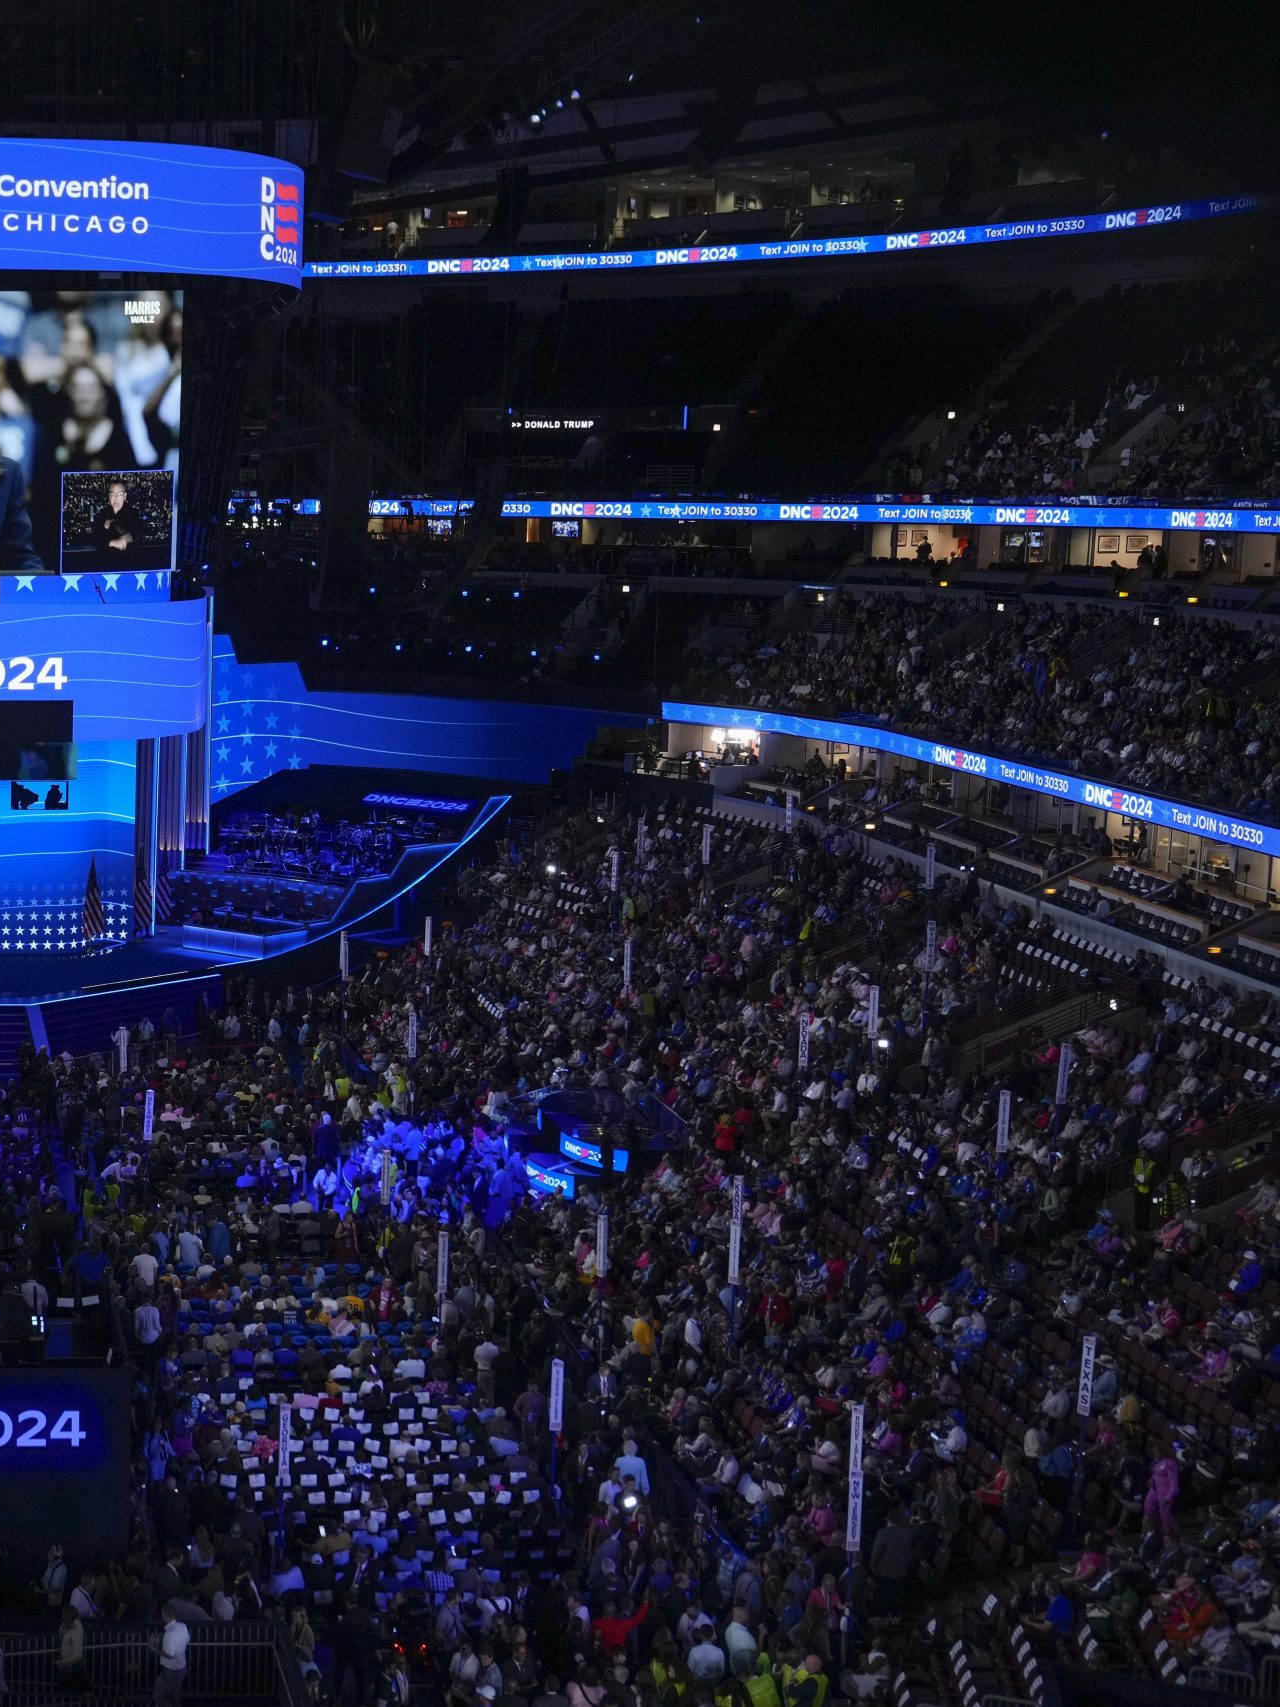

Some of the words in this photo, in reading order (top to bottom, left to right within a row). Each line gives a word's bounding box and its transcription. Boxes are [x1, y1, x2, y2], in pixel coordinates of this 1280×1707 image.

[1209, 202, 1229, 212] Text
[3, 214, 148, 234] CHICAGO
[1106, 212, 1136, 228] DNC
[1147, 206, 1181, 223] 2024
[985, 228, 1006, 237] Text
[1009, 225, 1034, 235] JOIN
[1037, 224, 1047, 232] to
[1050, 220, 1084, 231] 30330
[887, 234, 919, 249] DNC
[929, 230, 966, 245] 2024
[276, 246, 296, 265] 2024
[656, 250, 689, 264] DNC
[699, 247, 737, 261] 2024
[760, 246, 781, 255] Text
[784, 244, 809, 254] JOIN
[812, 244, 823, 252] to
[826, 241, 859, 252] 30330
[428, 260, 460, 273] DNC
[471, 259, 509, 271] 2024
[600, 255, 632, 264] 30330
[312, 265, 332, 273] Text
[335, 265, 360, 273] JOIN
[124, 301, 160, 315] HARRIS
[130, 315, 155, 324] WALZ
[525, 421, 560, 429] DONALD
[564, 421, 594, 429] TRUMP
[432, 503, 452, 513] Text
[503, 503, 531, 514] 0330
[551, 503, 584, 515] DNC
[594, 504, 632, 516] 2024
[682, 506, 708, 516] JOIN
[710, 506, 721, 516] to
[724, 507, 757, 515] 30330
[780, 506, 812, 519] DNC
[822, 506, 858, 519] 2024
[879, 509, 900, 518] Text
[902, 509, 927, 518] JOIN
[930, 509, 941, 519] to
[996, 509, 1026, 523] DNC
[1036, 510, 1069, 523] 2024
[1172, 512, 1197, 527] DNC
[1204, 511, 1232, 528] 2024
[1255, 515, 1272, 526] Text
[935, 746, 956, 765] DNC
[961, 754, 986, 773] 2024
[1001, 765, 1015, 779] Text
[1016, 770, 1034, 783] JOIN
[1036, 774, 1043, 786] to
[1044, 776, 1068, 792] 30330
[419, 800, 469, 812] 2024
[1085, 784, 1112, 806] DNC
[1122, 795, 1153, 817] 2024
[1172, 809, 1191, 825] Text
[1193, 815, 1216, 832] JOIN
[1219, 822, 1228, 835] to
[1231, 824, 1263, 844] 30330
[927, 926, 936, 965] WYOMING
[800, 1019, 809, 1060] NEVADA
[145, 1096, 153, 1134] DELAWARE
[543, 1174, 568, 1190] 2024
[734, 1183, 742, 1221] KANSA
[1080, 1346, 1093, 1406] TEXAS
[281, 1413, 289, 1467] GEORGIA
[850, 1480, 860, 1500] NEW
